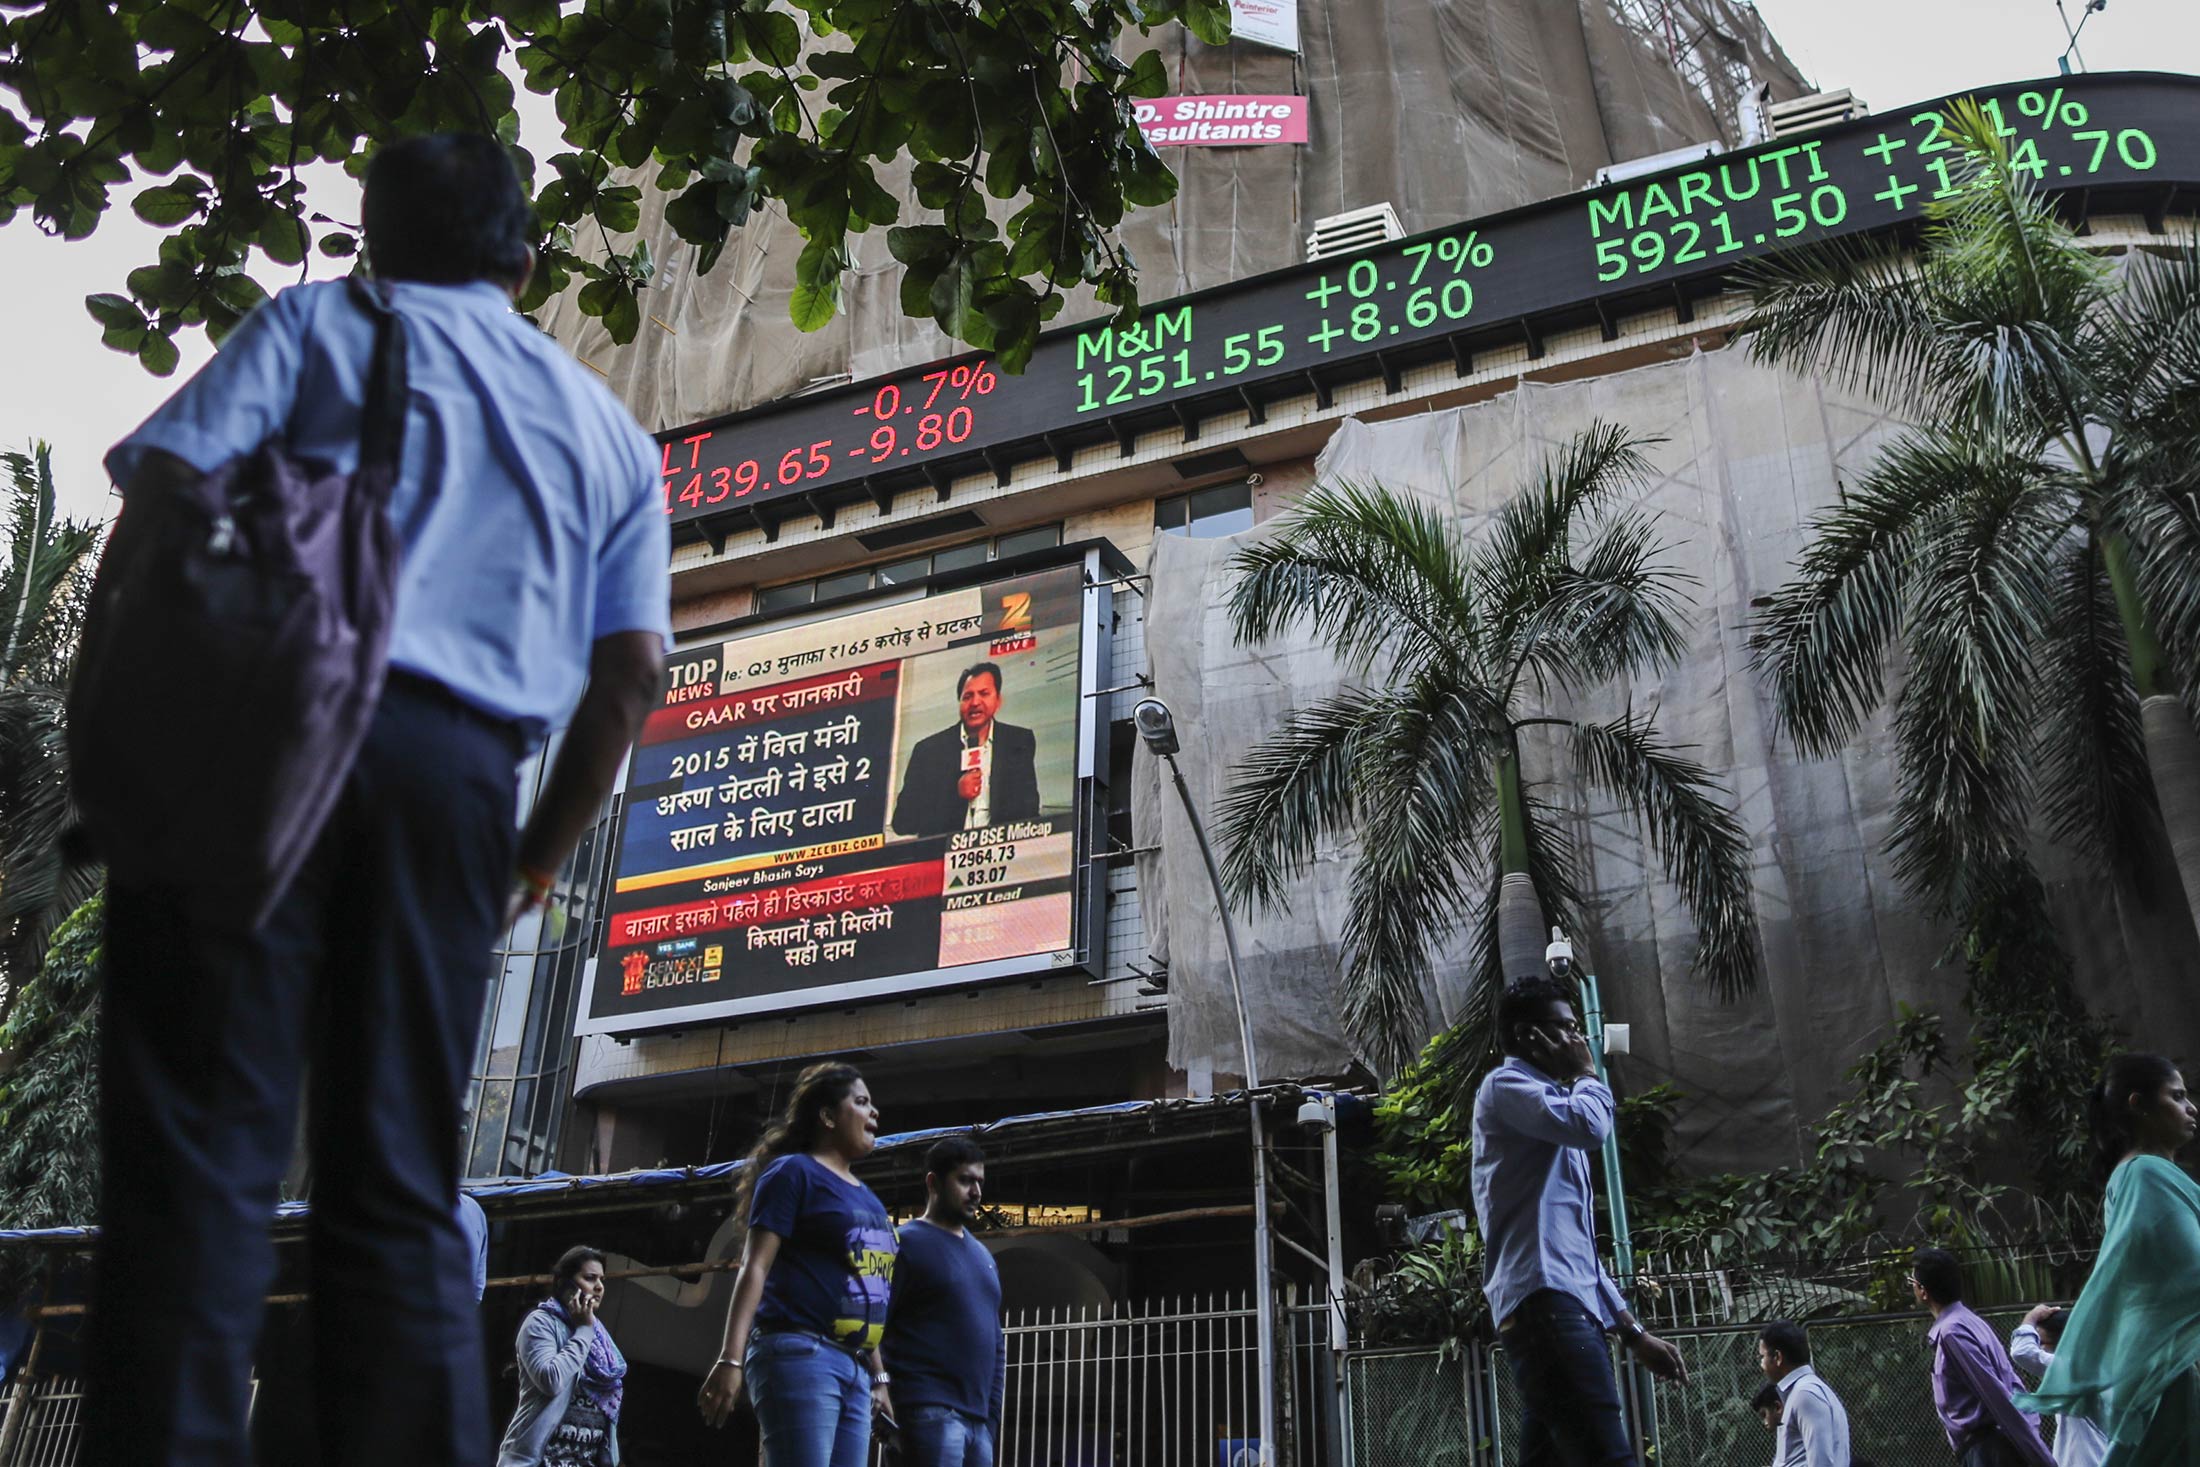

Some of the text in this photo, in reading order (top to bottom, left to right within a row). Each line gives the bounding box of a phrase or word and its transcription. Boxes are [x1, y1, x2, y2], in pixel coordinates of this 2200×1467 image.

[1174, 101, 1291, 121] Shintre
[1588, 140, 1829, 239] MARUTI
[1596, 184, 1848, 282] 5921.50
[1077, 231, 1494, 370] M&M +0.7%
[1076, 279, 1473, 413] 1251.55 +8.60
[661, 360, 996, 477] LT -0.7%
[662, 406, 974, 514] 1439.65 -9.80
[747, 660, 772, 677] Q3
[875, 627, 913, 649] करोड़
[917, 621, 932, 641] से
[936, 615, 982, 636] घटकर
[996, 639, 1030, 654] LIVE
[666, 682, 713, 705] NEWS
[668, 658, 717, 689] TOP
[686, 671, 864, 729] GAAR पर जानकारी
[669, 714, 861, 779] 2015 में वित्त मंत्री
[656, 754, 871, 817] अरुण जेटली ने इसे 2
[670, 798, 856, 852] साल के लिए टाला
[951, 822, 1052, 850] S&P BSE Midcap
[703, 864, 824, 892] Sanjeev Bhasin Says
[950, 844, 1016, 870] 12964.73
[967, 866, 1008, 886] 83.07
[675, 900, 718, 933] इसको
[763, 889, 782, 918] ही
[946, 887, 1023, 910] MCX Lead
[747, 905, 894, 951] किसानों को मिलेंगे
[784, 939, 857, 967] सही दाम
